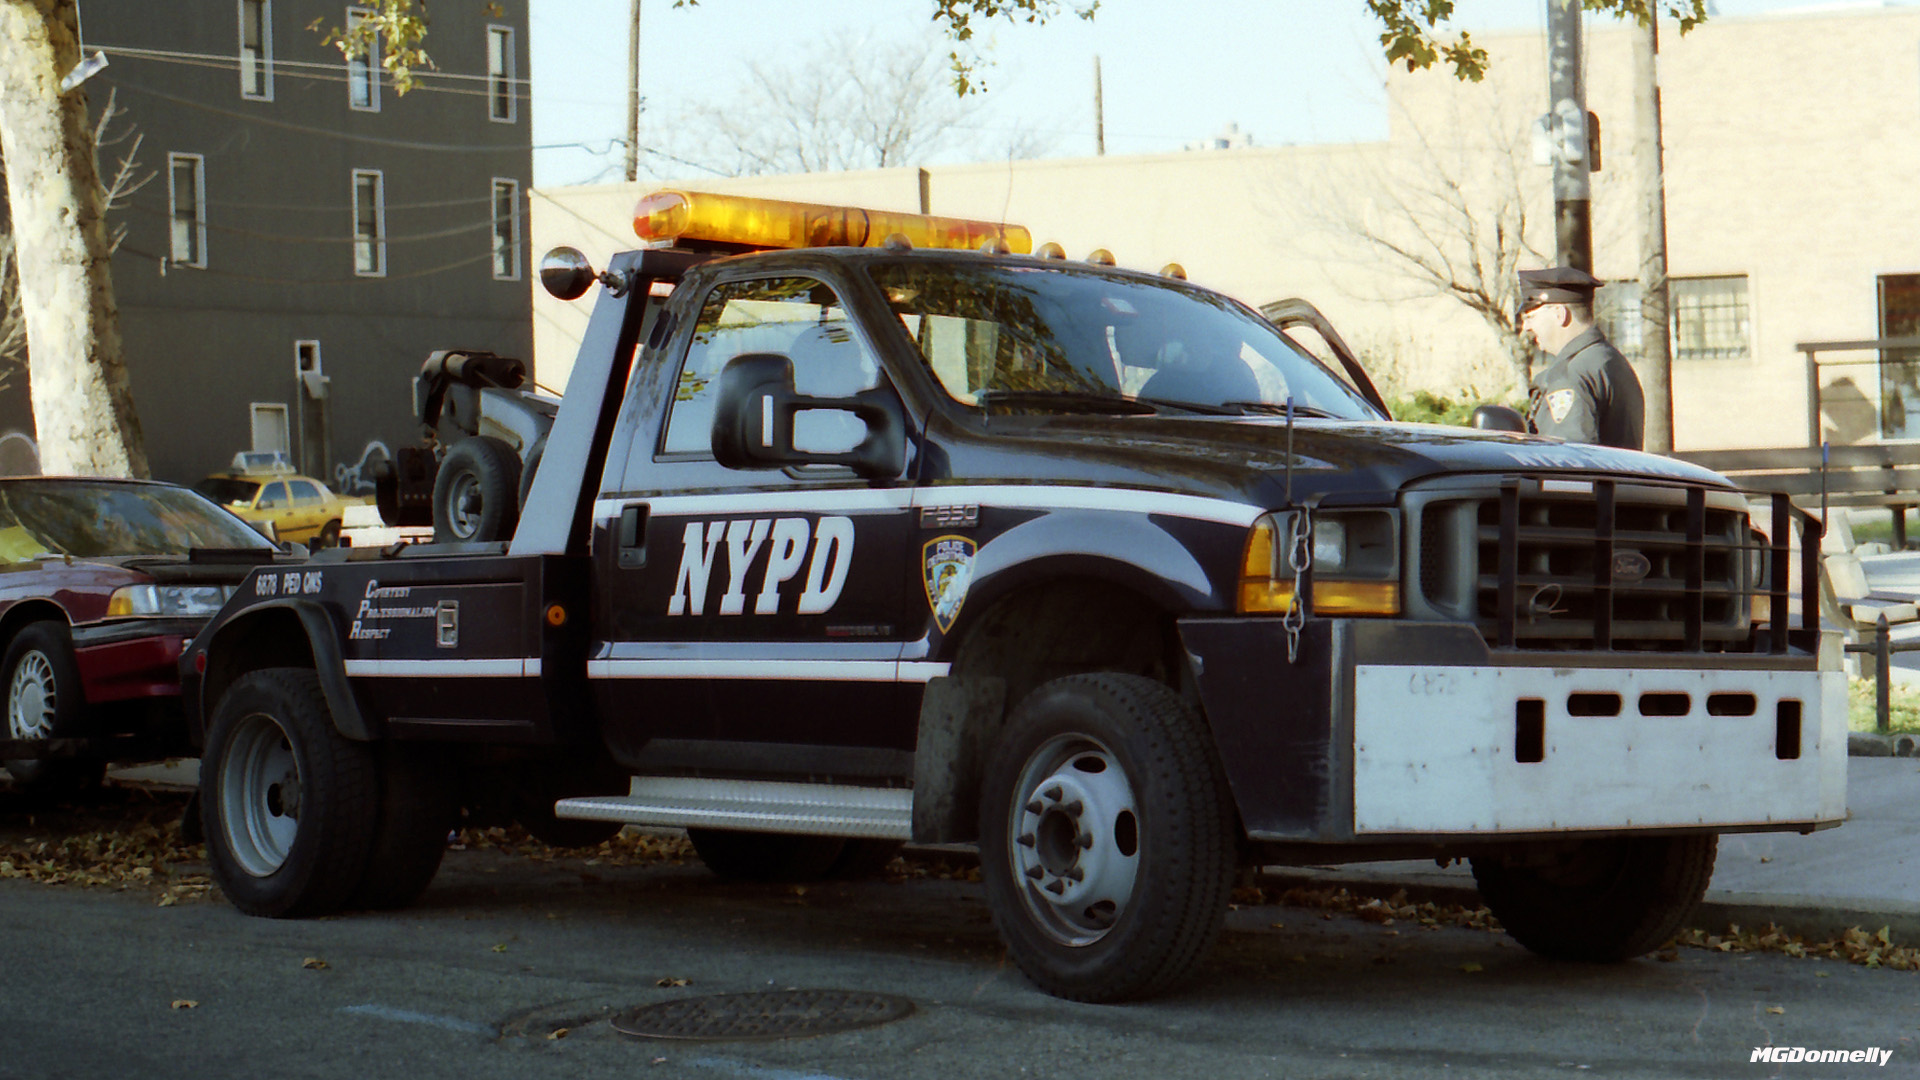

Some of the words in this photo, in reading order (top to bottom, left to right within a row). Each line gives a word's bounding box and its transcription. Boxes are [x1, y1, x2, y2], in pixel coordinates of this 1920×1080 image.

[921, 505, 979, 521] F550
[937, 541, 964, 553] POLICE
[667, 516, 854, 615] NYPD
[282, 572, 301, 595] PED
[348, 620, 391, 640] RESPECT
